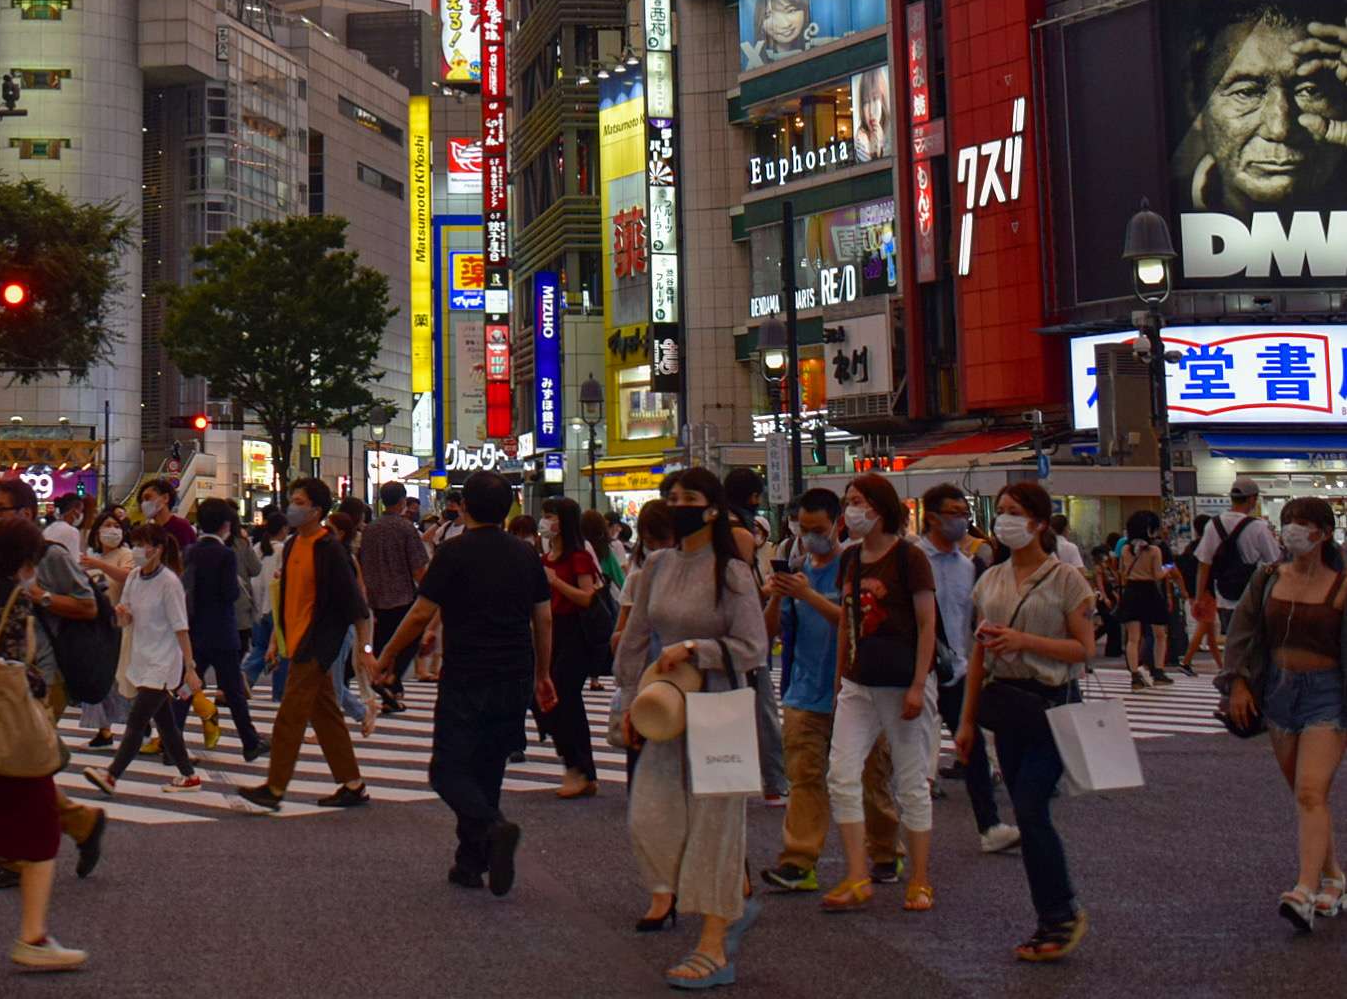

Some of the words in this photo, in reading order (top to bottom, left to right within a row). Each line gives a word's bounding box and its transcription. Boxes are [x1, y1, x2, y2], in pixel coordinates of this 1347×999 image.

[602, 119, 640, 136] Matsumoto
[415, 134, 426, 182] KiYoshi
[749, 136, 849, 186] Euphoria
[416, 184, 426, 263] Matsumoto
[664, 200, 673, 233] フルーツ
[655, 273, 664, 307] フルーツ
[820, 264, 857, 307] RE/D
[413, 313, 428, 328] 薬
[540, 285, 554, 339] MIZUHO
[540, 377, 554, 435] みずほ銀行
